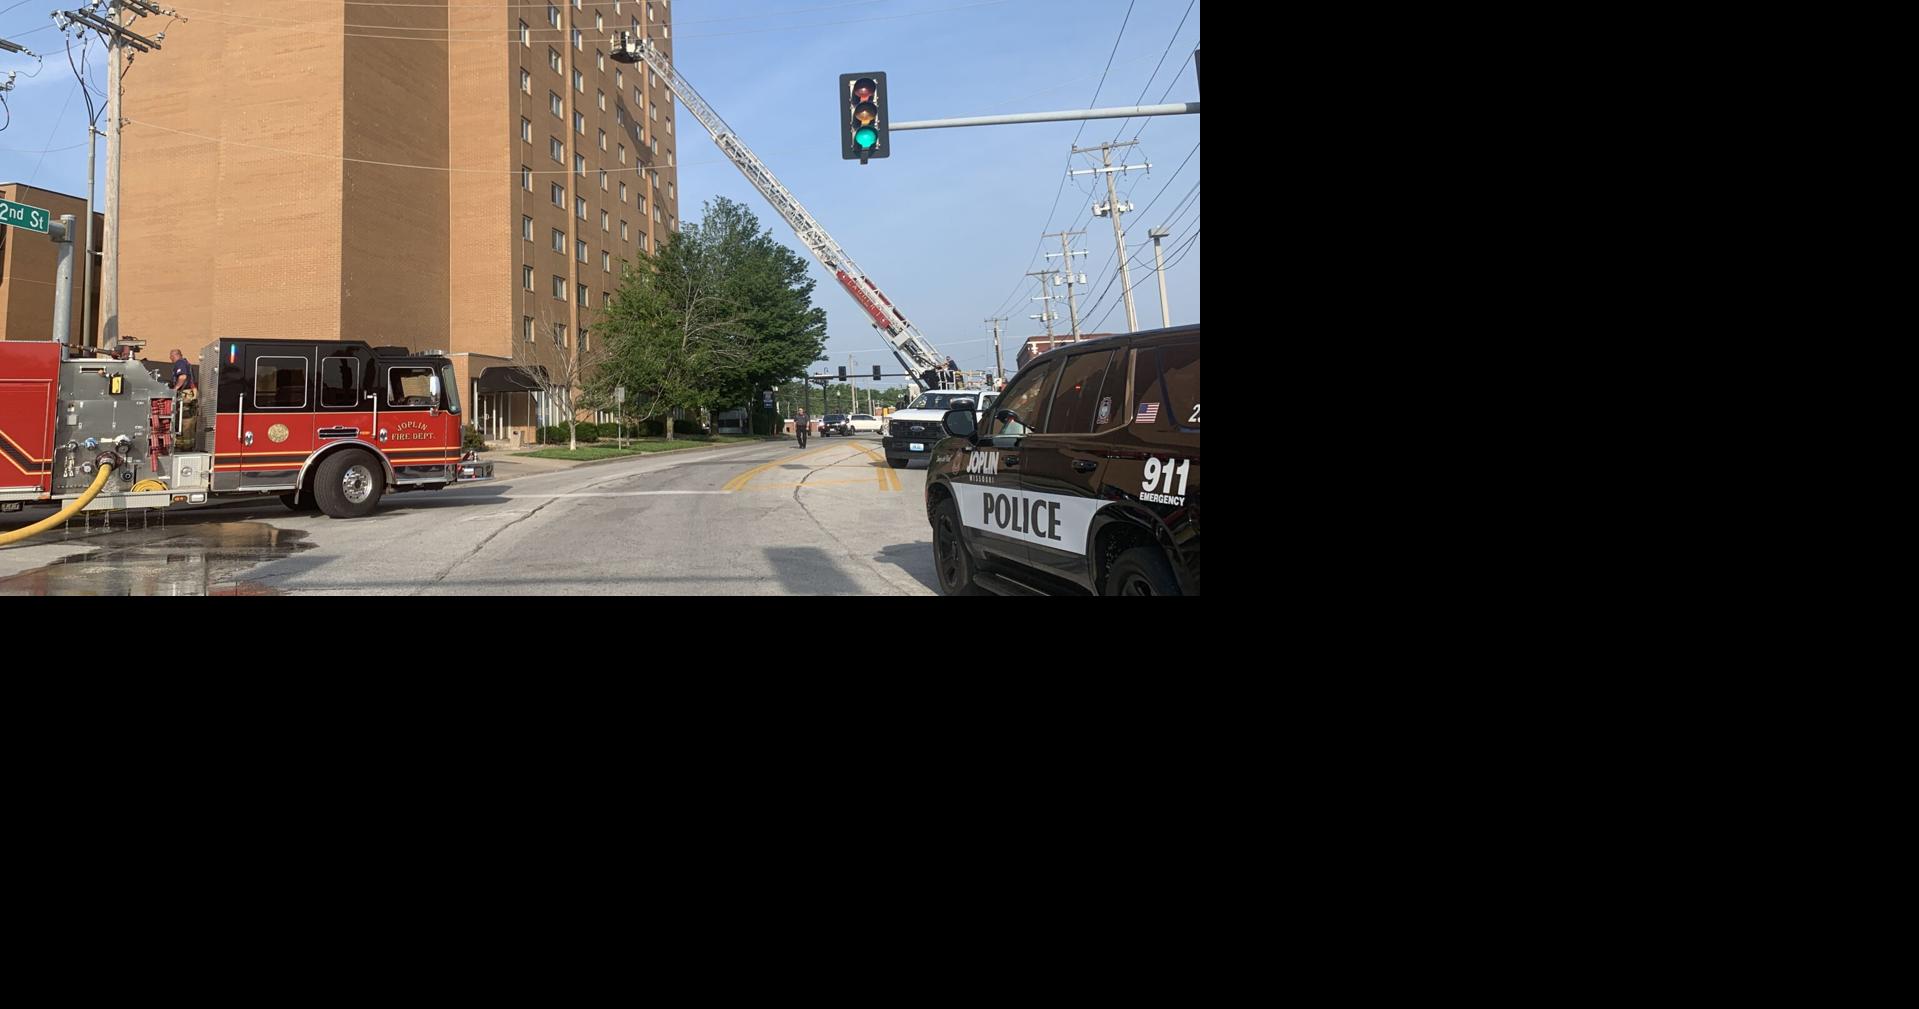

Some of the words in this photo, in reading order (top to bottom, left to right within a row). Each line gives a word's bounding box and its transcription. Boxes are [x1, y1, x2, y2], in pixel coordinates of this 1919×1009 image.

[30, 211, 43, 229] St
[1188, 404, 1200, 423] 2
[397, 421, 428, 431] JOPLIN
[967, 451, 999, 475] JOPLIN
[1142, 457, 1190, 496] 911
[1140, 492, 1185, 506] EMERGENCY
[983, 492, 1061, 541] POLICE
